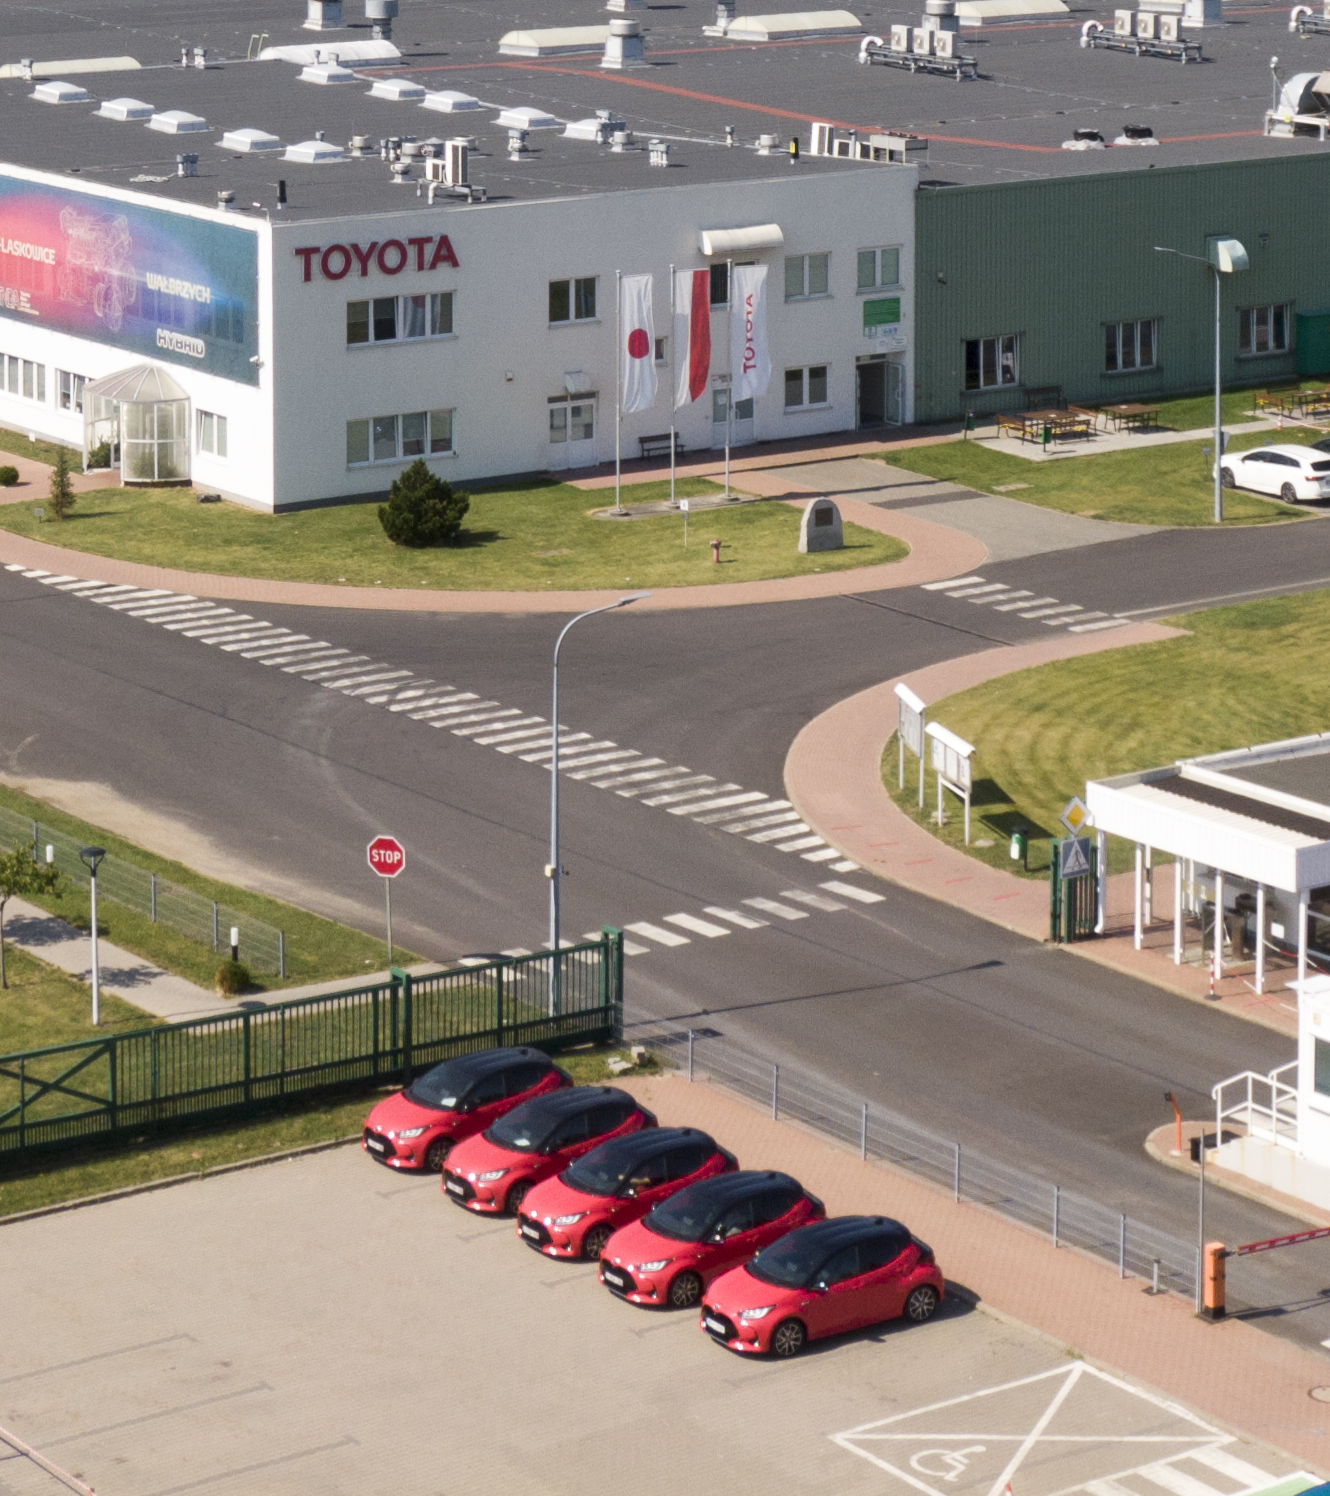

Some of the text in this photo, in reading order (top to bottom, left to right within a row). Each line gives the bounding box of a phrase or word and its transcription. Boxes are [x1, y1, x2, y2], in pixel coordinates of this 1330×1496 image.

[293, 234, 460, 283] TOYOTA
[743, 293, 756, 374] TOYOTA
[371, 849, 401, 864] STOP
